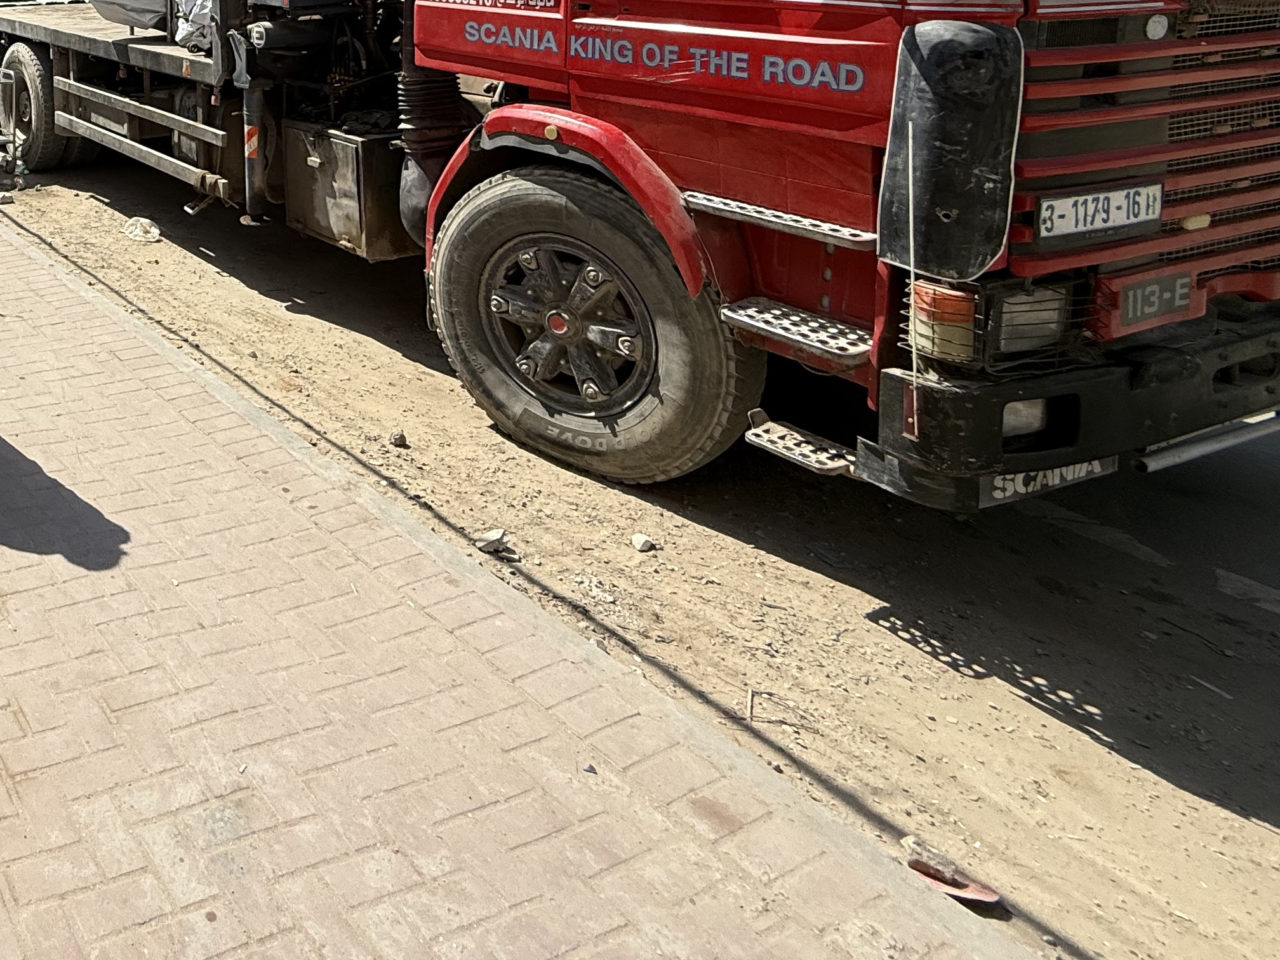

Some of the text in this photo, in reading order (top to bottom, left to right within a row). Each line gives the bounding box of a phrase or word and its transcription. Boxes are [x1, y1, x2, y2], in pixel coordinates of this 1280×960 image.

[463, 21, 866, 94] SCANIA KING OF THE ROAD
[1126, 277, 1191, 319] 113-E
[991, 459, 1103, 500] SCANIA
